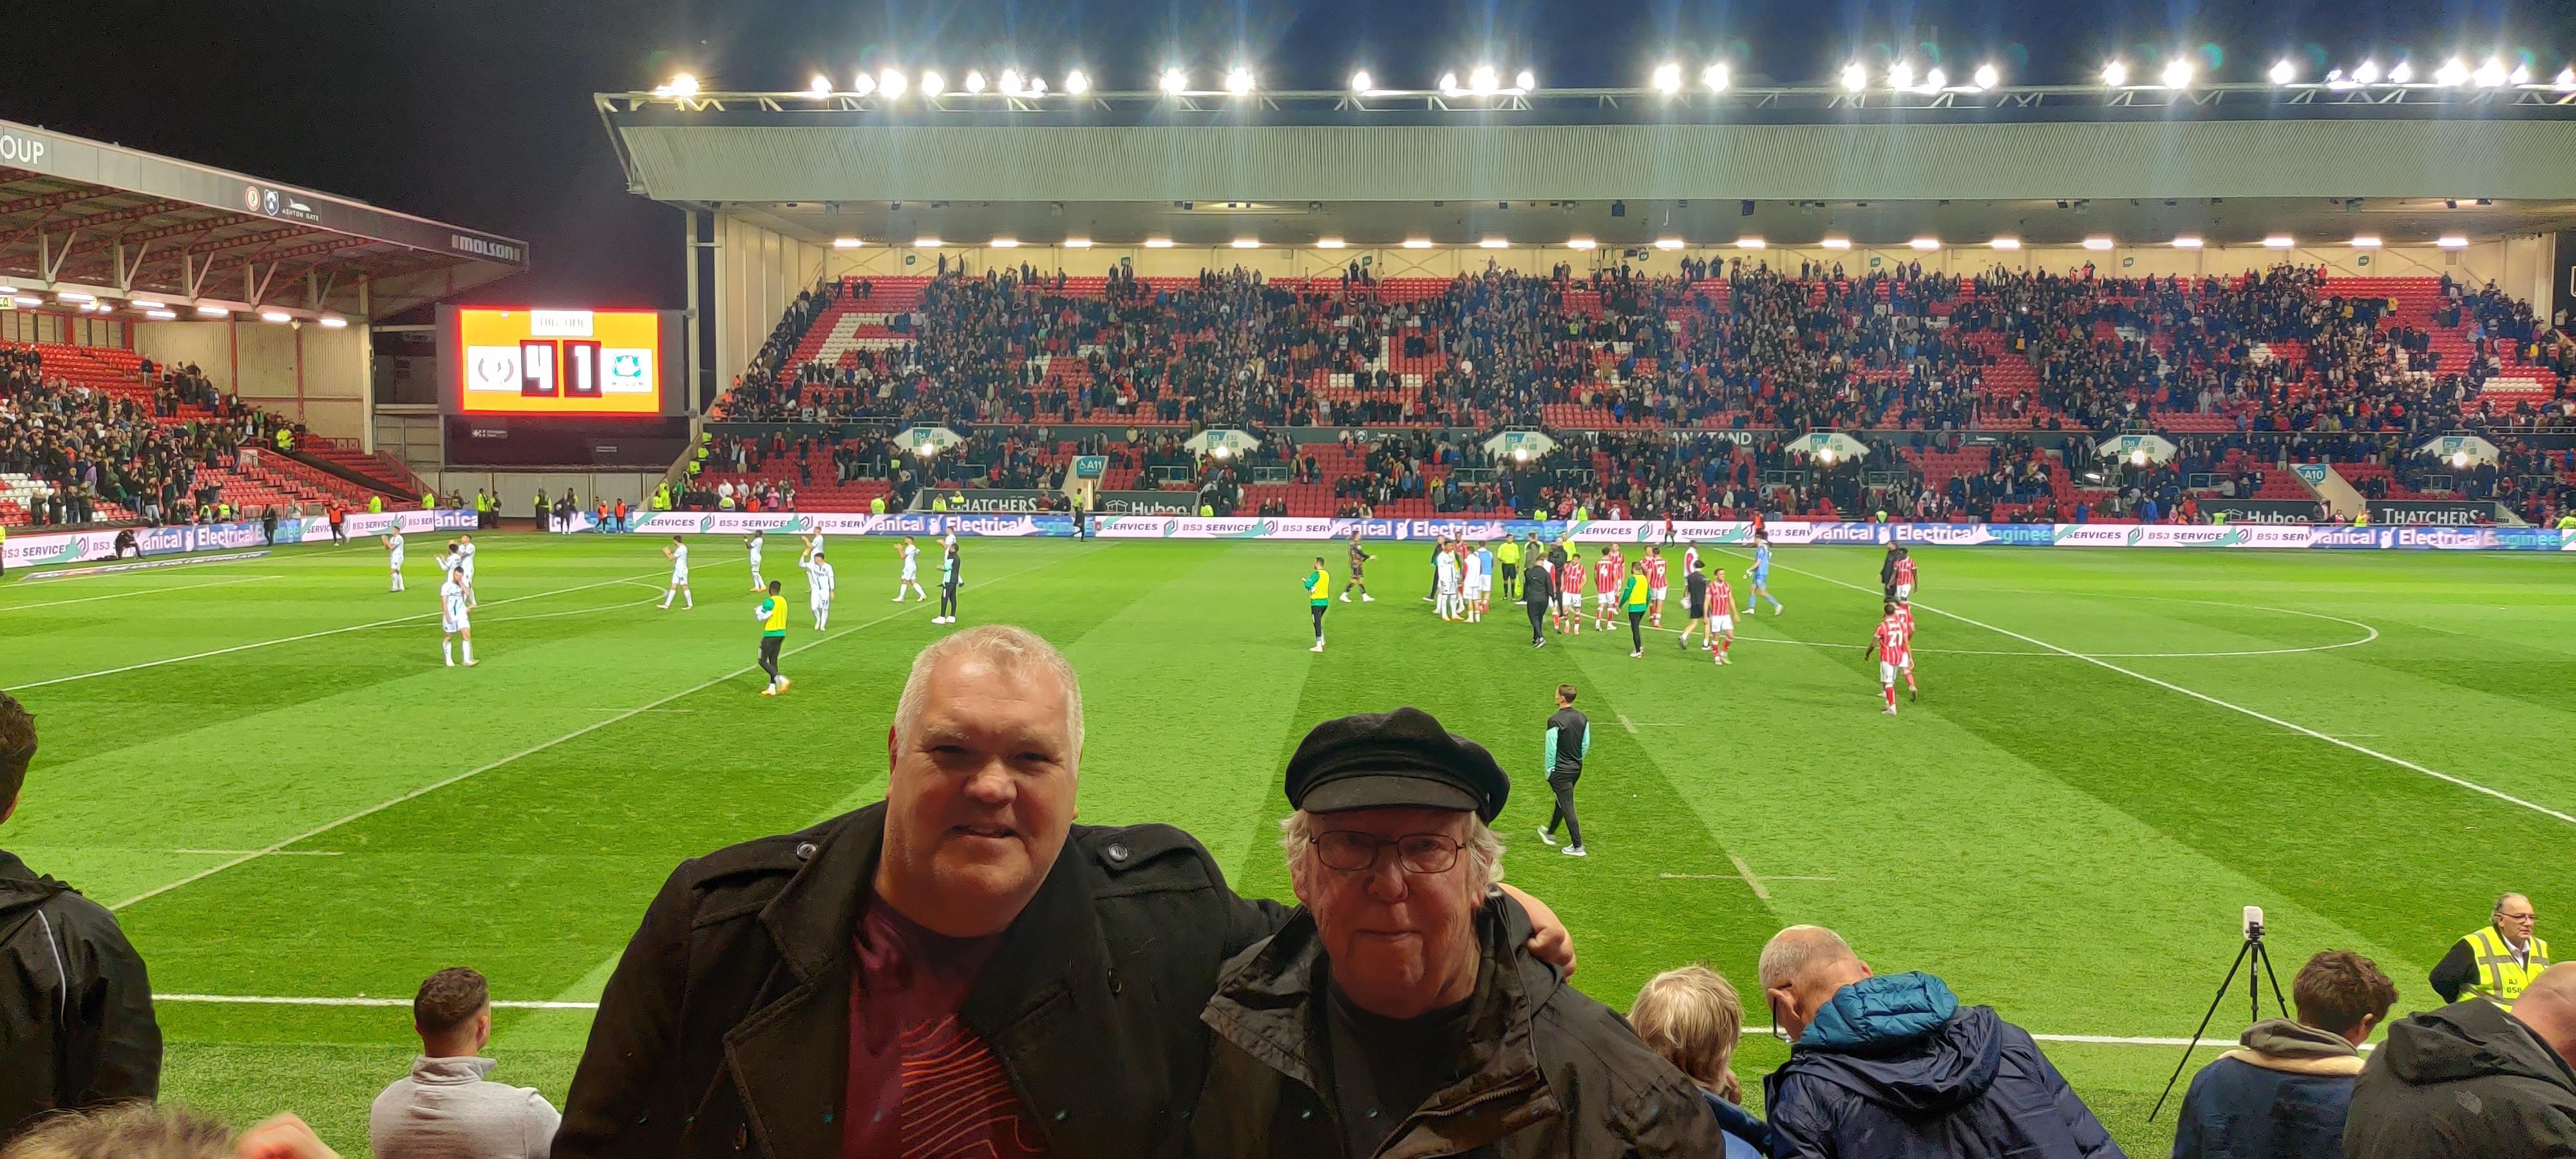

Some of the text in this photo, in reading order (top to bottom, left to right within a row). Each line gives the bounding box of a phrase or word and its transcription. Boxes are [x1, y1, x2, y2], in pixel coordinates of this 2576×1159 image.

[0, 135, 44, 165] OUP
[282, 208, 319, 221] ASHTON GATE
[526, 344, 592, 390] 4 1
[1086, 460, 1102, 470] A11
[2304, 470, 2324, 480] A10
[2382, 507, 2479, 525] THATCHERS
[2484, 532, 2562, 549] Enginee
[1888, 630, 1903, 647] 21
